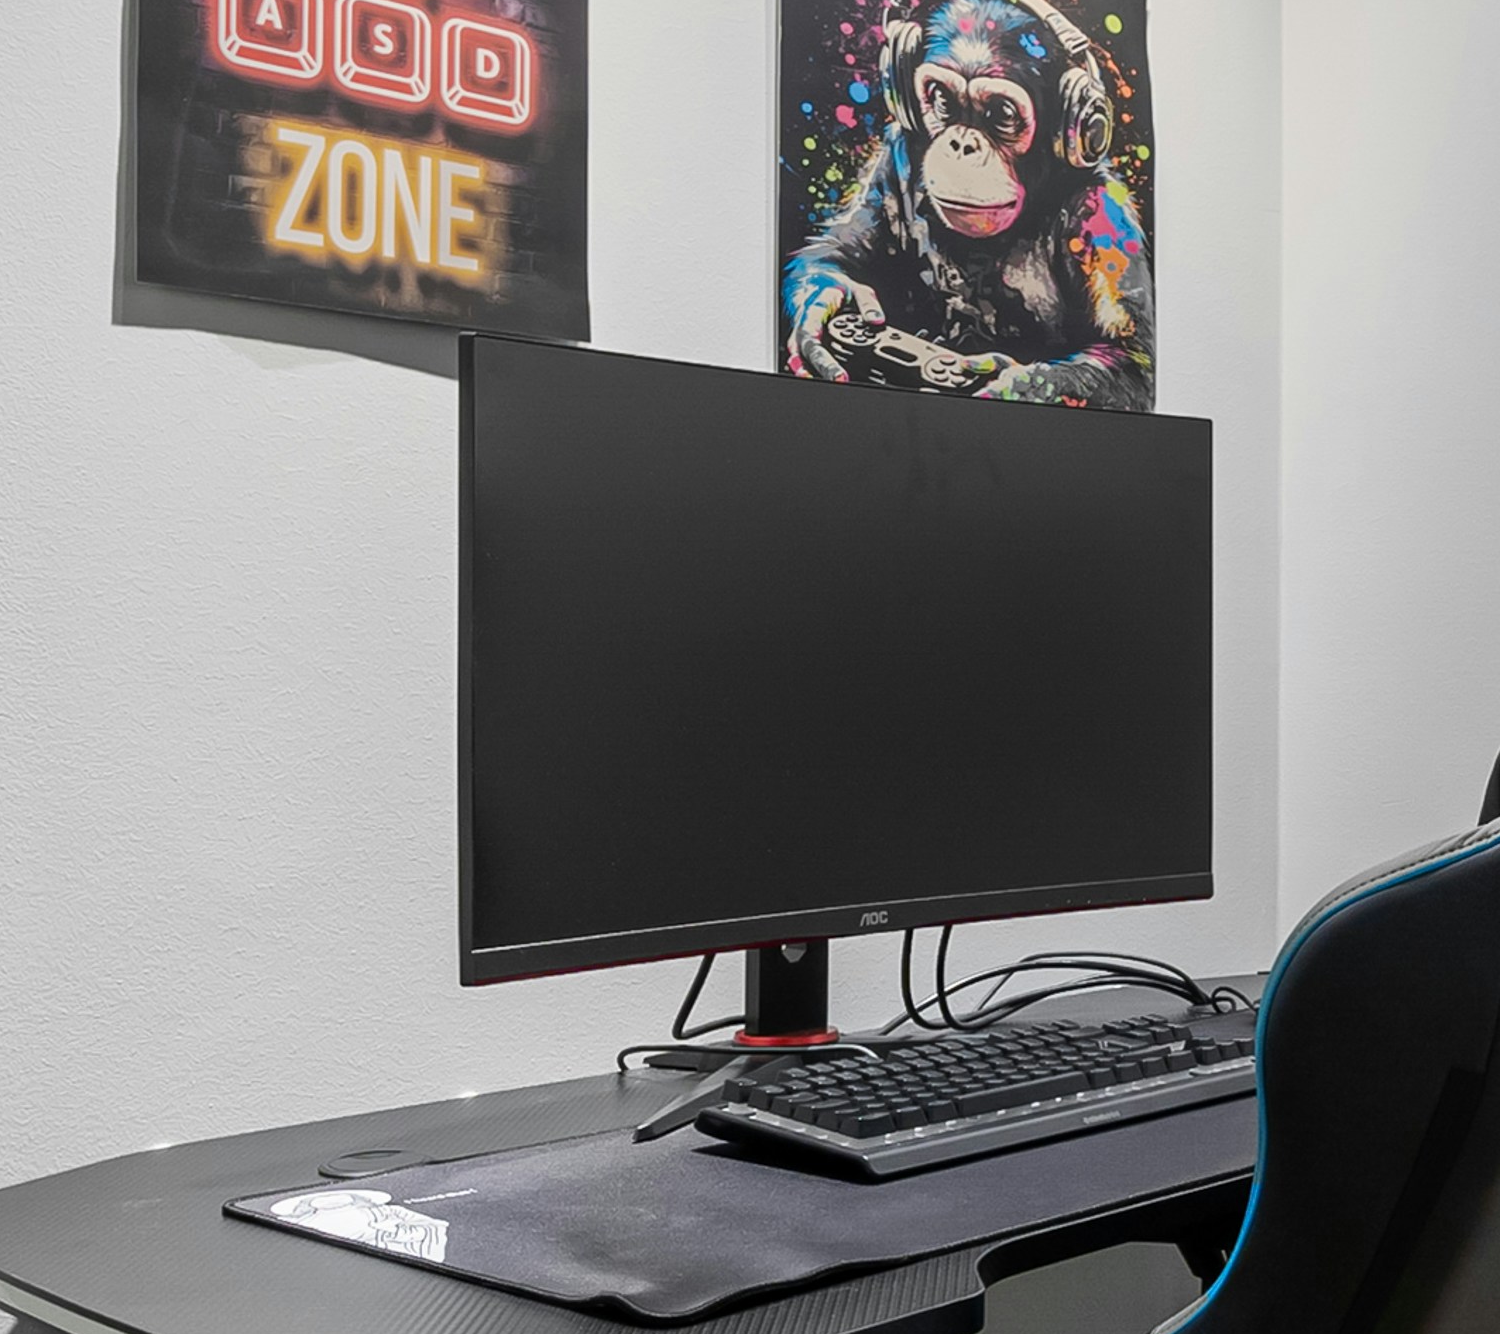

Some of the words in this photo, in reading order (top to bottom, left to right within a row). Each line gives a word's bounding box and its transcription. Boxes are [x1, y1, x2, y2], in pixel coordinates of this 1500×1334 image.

[372, 23, 395, 56] S
[475, 47, 501, 80] D
[274, 127, 481, 272] ZONE
[860, 910, 889, 927] AOC
